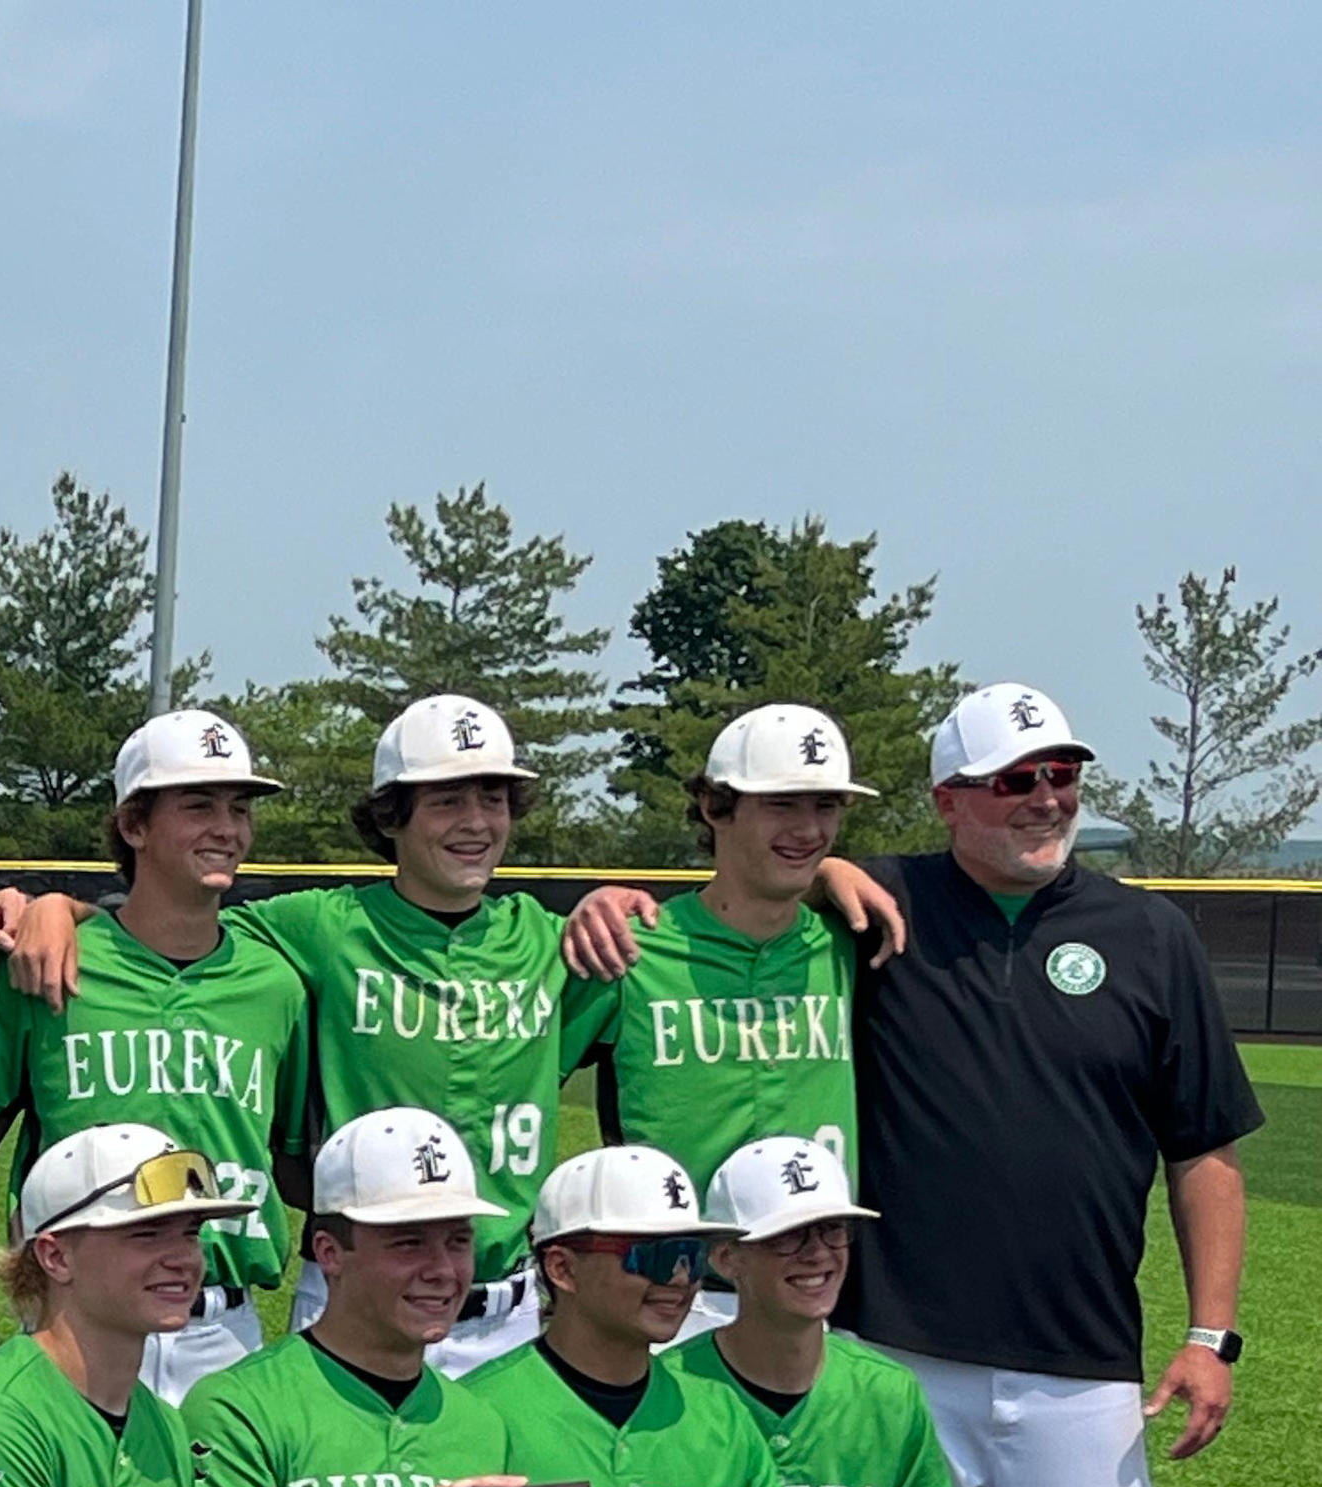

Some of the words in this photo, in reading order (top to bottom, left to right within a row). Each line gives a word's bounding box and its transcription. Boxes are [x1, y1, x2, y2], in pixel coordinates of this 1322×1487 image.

[352, 968, 554, 1042] EUREKA
[648, 995, 850, 1067] EUREKA
[63, 1028, 263, 1115] EUREKA
[489, 1103, 543, 1176] 19
